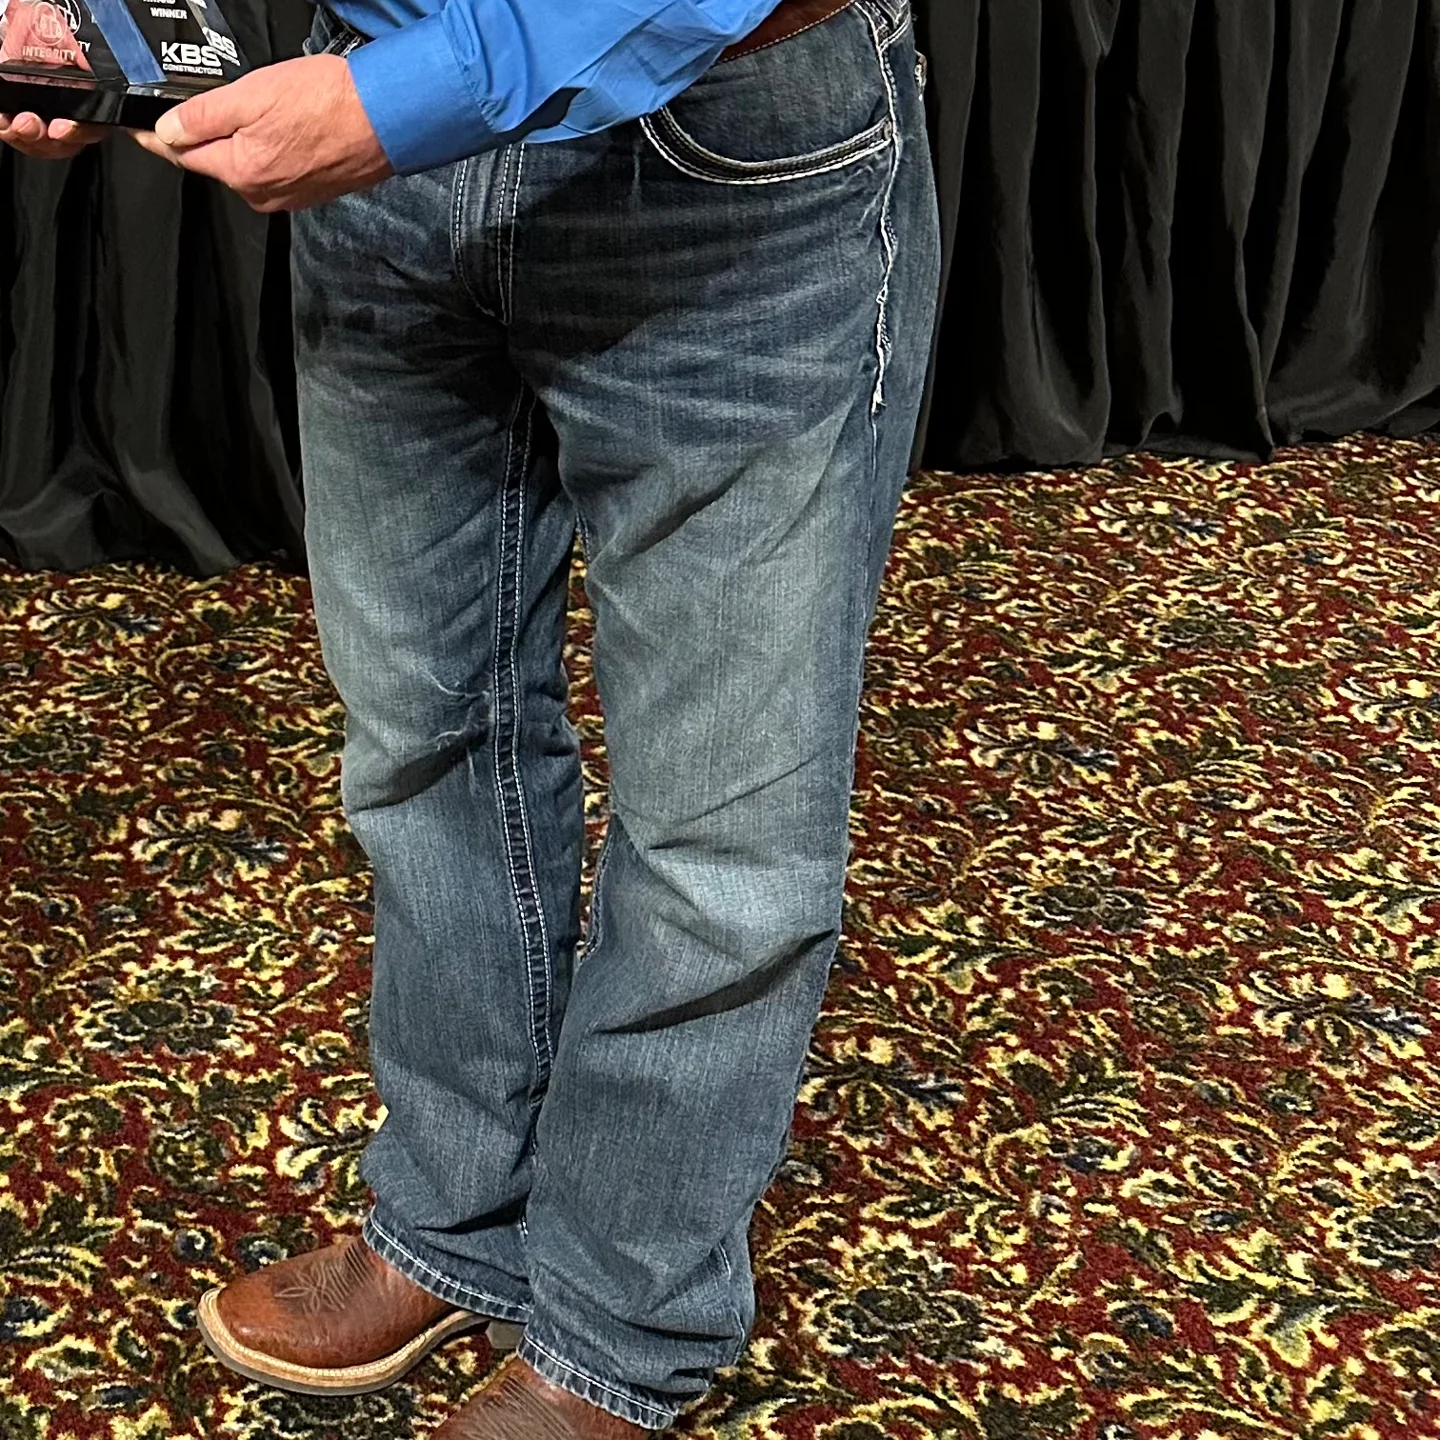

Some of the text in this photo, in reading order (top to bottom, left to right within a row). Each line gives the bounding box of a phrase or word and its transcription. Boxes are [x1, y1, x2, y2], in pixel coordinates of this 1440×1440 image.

[150, 7, 188, 20] WINNER
[22, 45, 77, 61] INTEGRITY
[161, 41, 222, 67] KBS
[162, 63, 224, 76] CONSTRUCTORS
